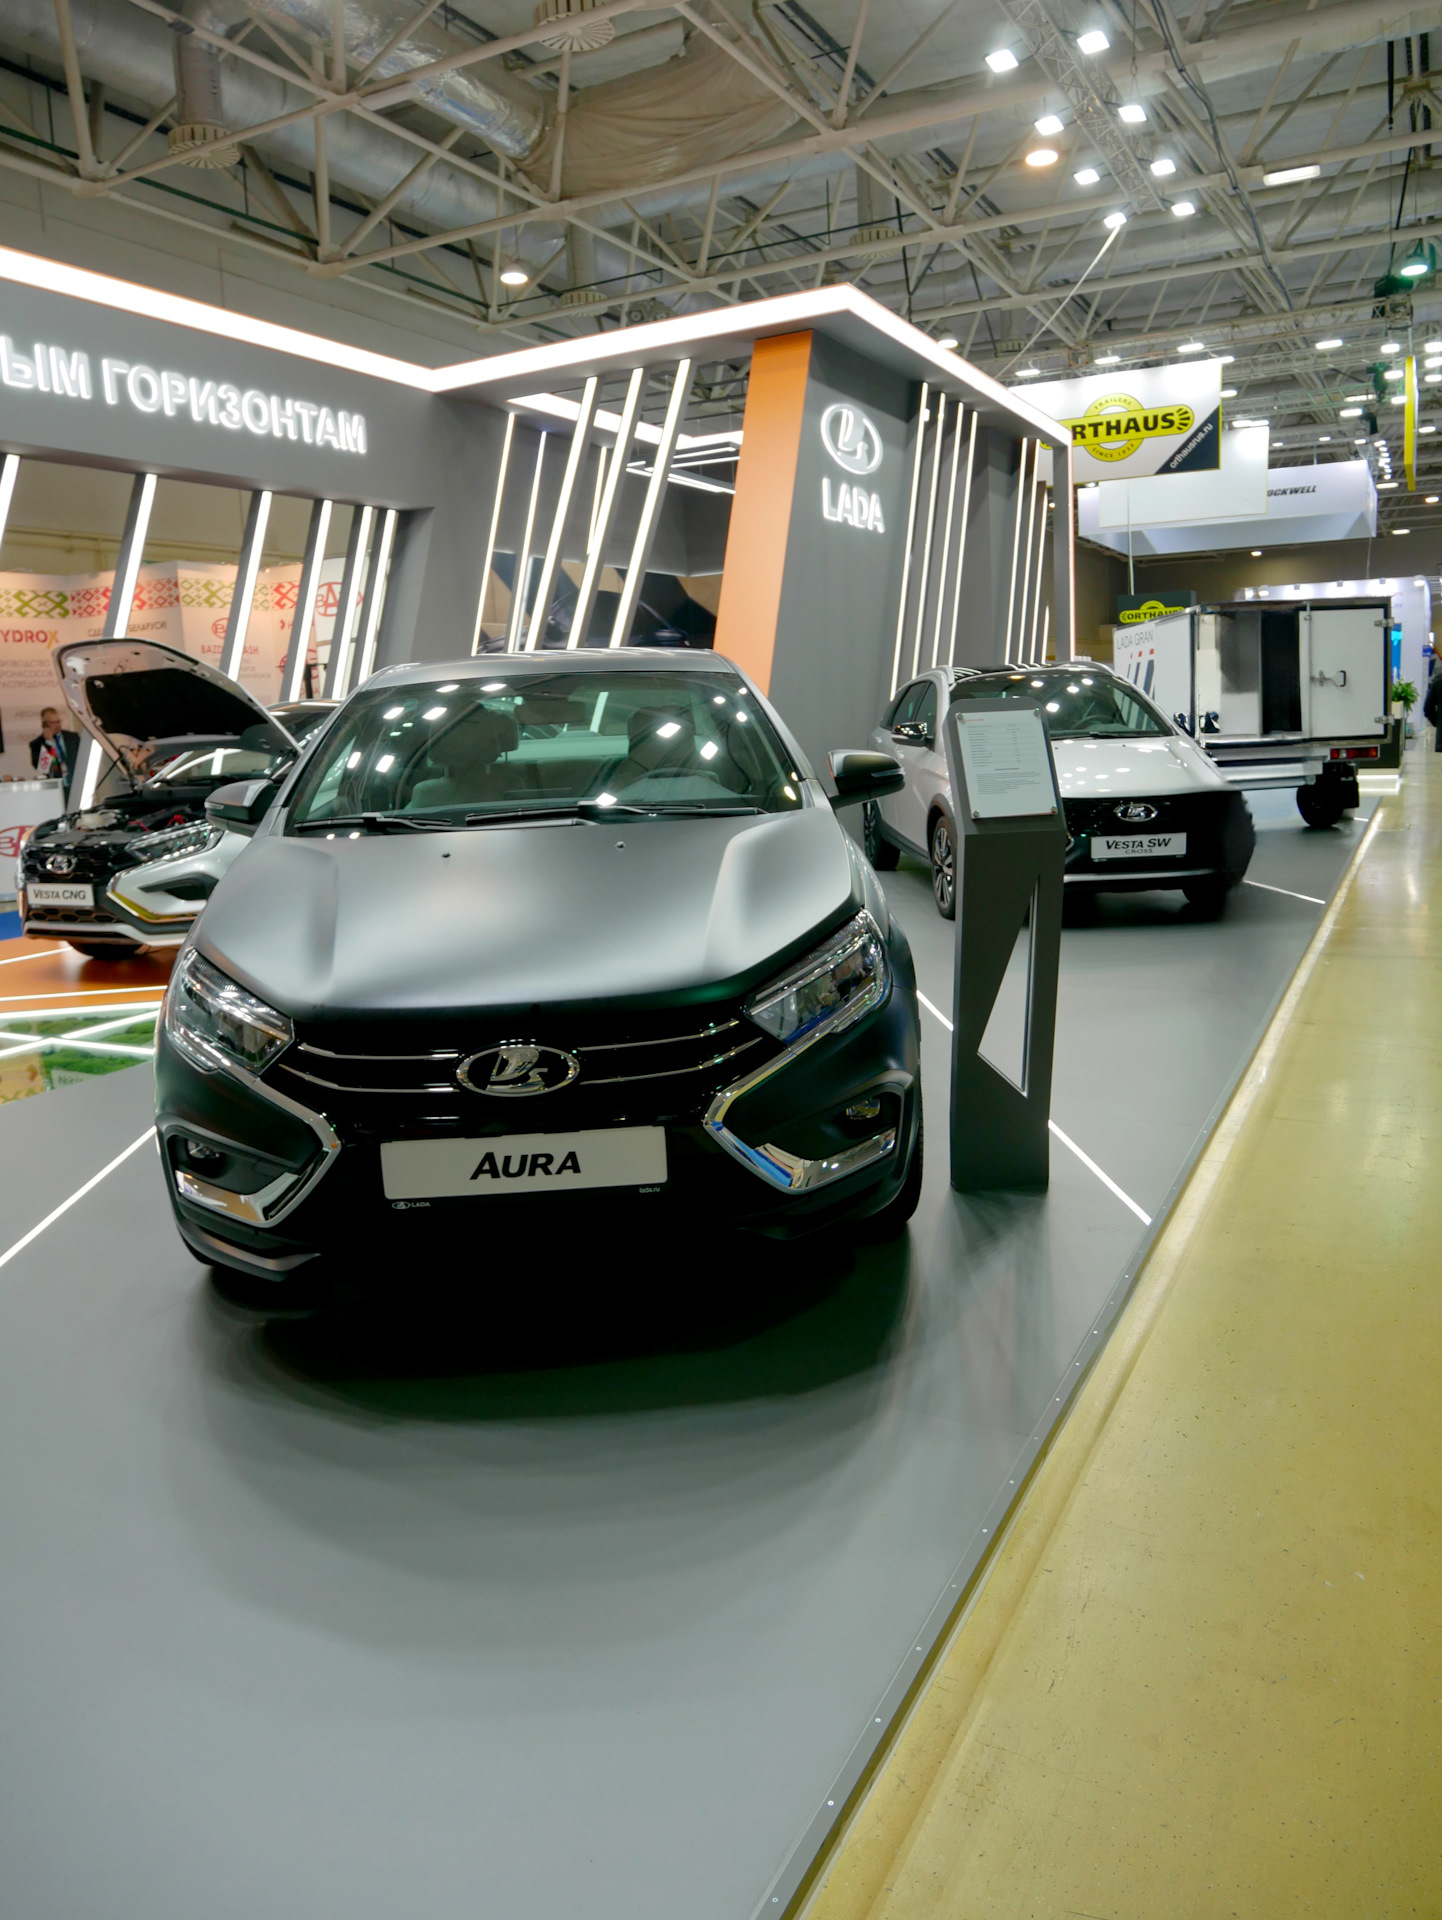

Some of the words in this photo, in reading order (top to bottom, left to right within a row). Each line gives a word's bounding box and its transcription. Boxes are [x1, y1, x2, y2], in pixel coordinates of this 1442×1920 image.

[0, 334, 92, 399] ЫМ
[102, 357, 368, 454] ГОРИЗОНТАМ
[1071, 412, 1175, 440] RTHAUS
[1092, 446, 1113, 458] SINCE
[1170, 423, 1213, 469] orthausrus.ru
[822, 476, 885, 533] LADA
[1116, 636, 1134, 650] LADA
[1106, 840, 1144, 850] VESTA
[1147, 838, 1171, 848] SW
[33, 889, 60, 900] VESTA
[62, 890, 86, 900] CNG
[469, 1151, 581, 1180] AURA
[639, 1186, 660, 1194] lada.ru
